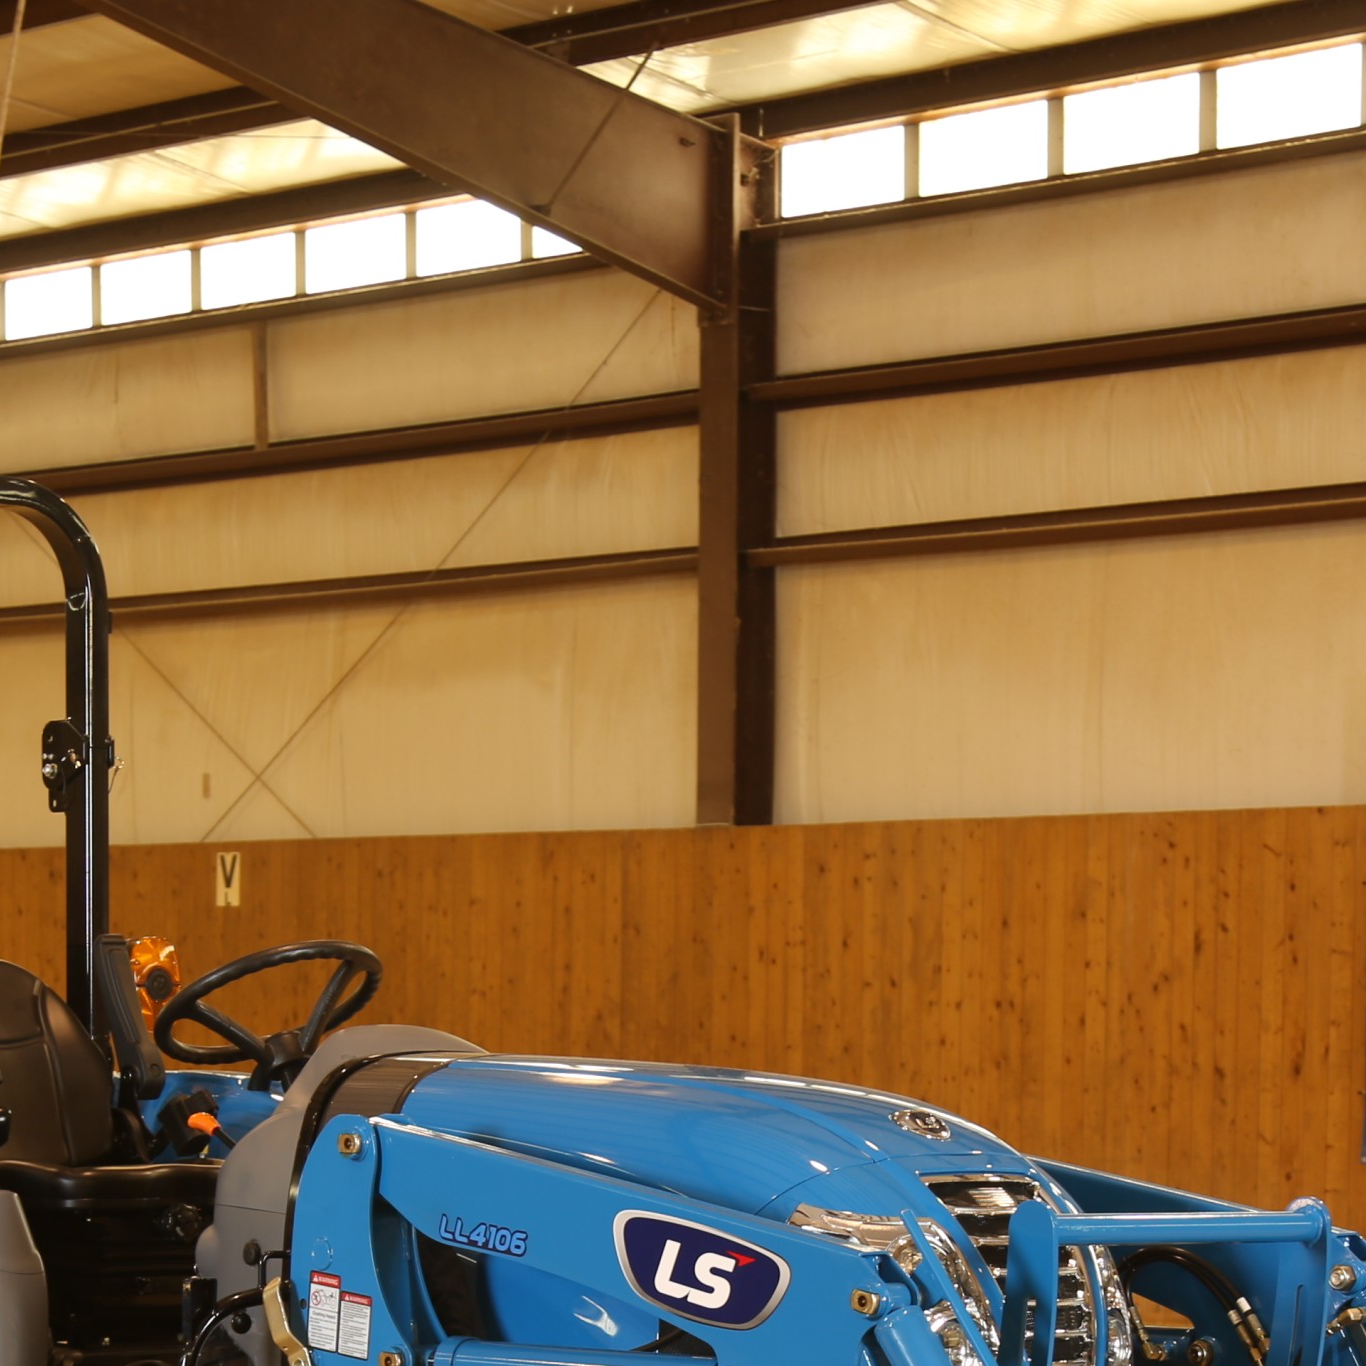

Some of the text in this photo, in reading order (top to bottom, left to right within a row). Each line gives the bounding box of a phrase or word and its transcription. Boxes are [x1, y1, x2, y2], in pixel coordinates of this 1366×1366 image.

[220, 854, 237, 888] V
[438, 1212, 528, 1257] LL4106
[653, 1239, 737, 1310] LS
